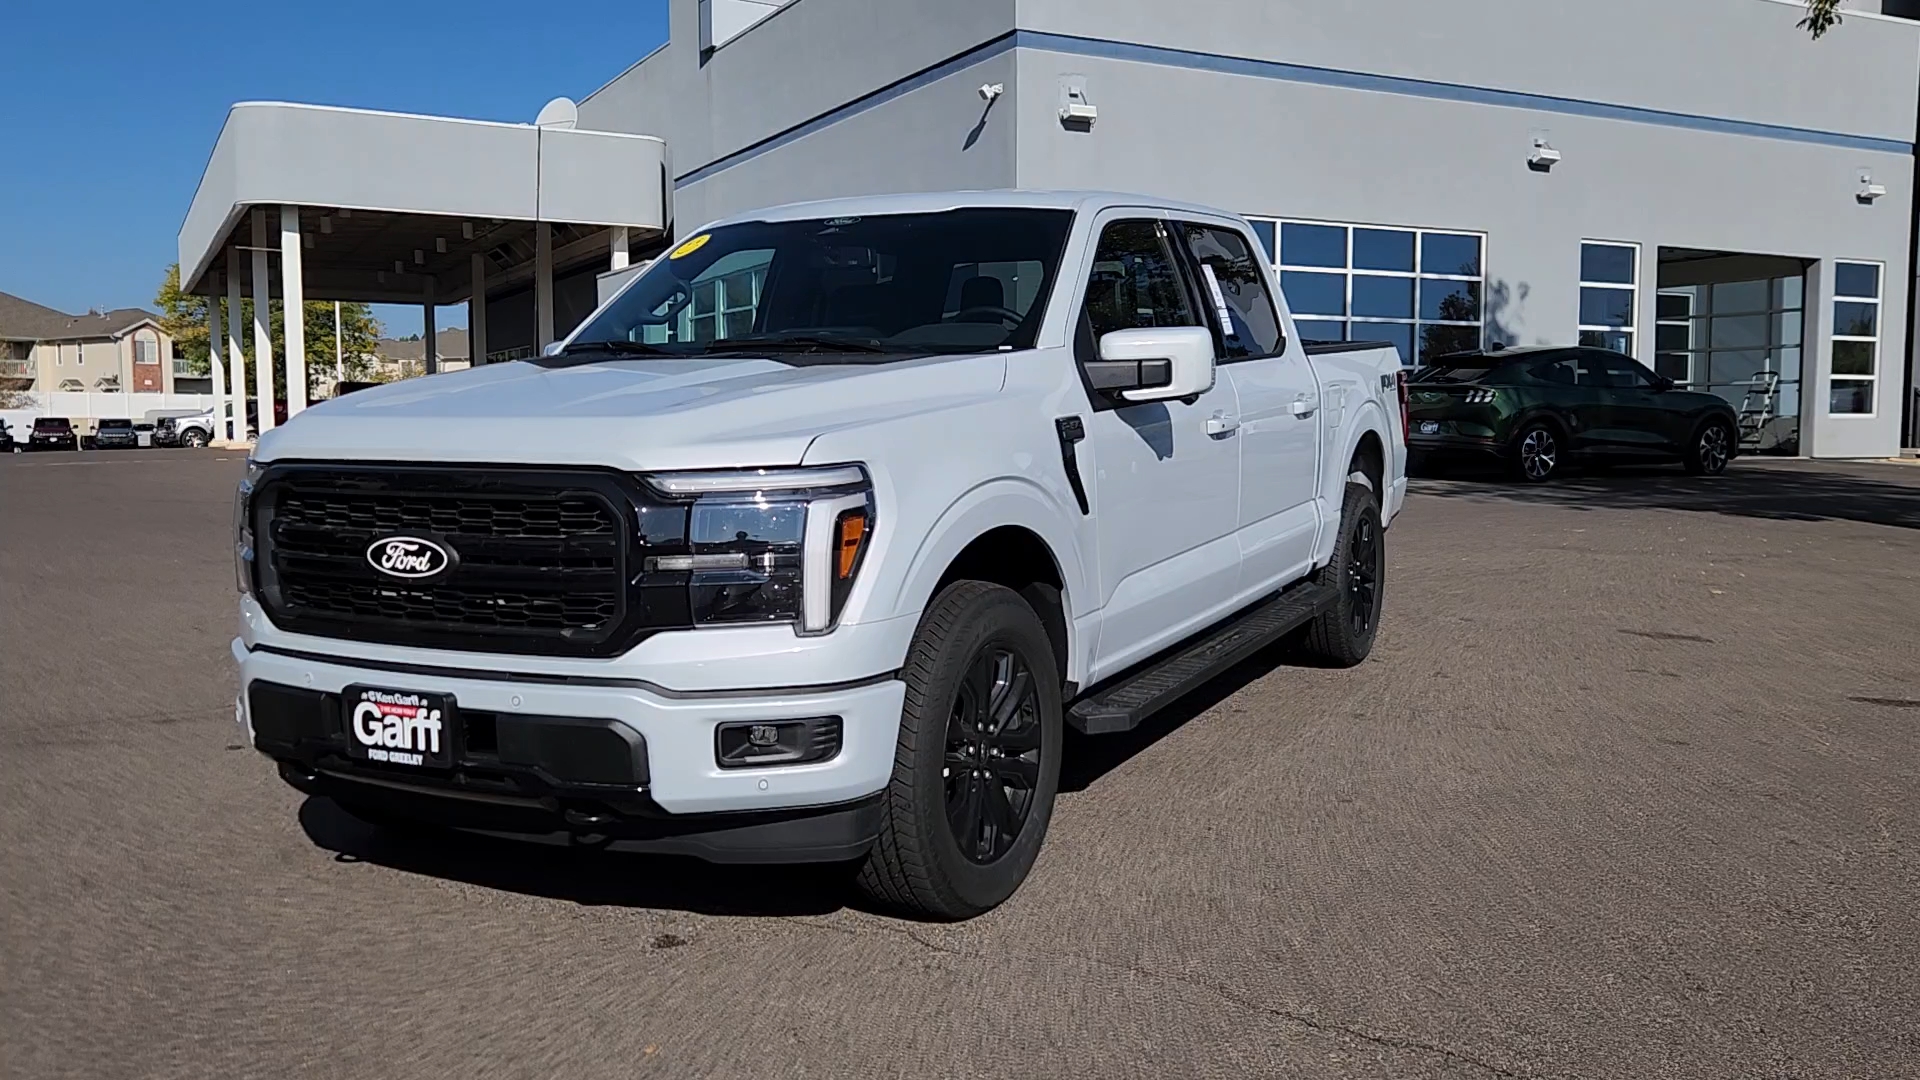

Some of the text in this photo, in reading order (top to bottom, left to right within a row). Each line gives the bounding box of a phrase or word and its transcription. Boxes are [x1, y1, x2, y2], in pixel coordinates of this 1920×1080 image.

[381, 542, 431, 571] Ford
[380, 691, 424, 706] Ken Garff
[353, 701, 442, 753] Garff
[368, 748, 388, 762] FORD
